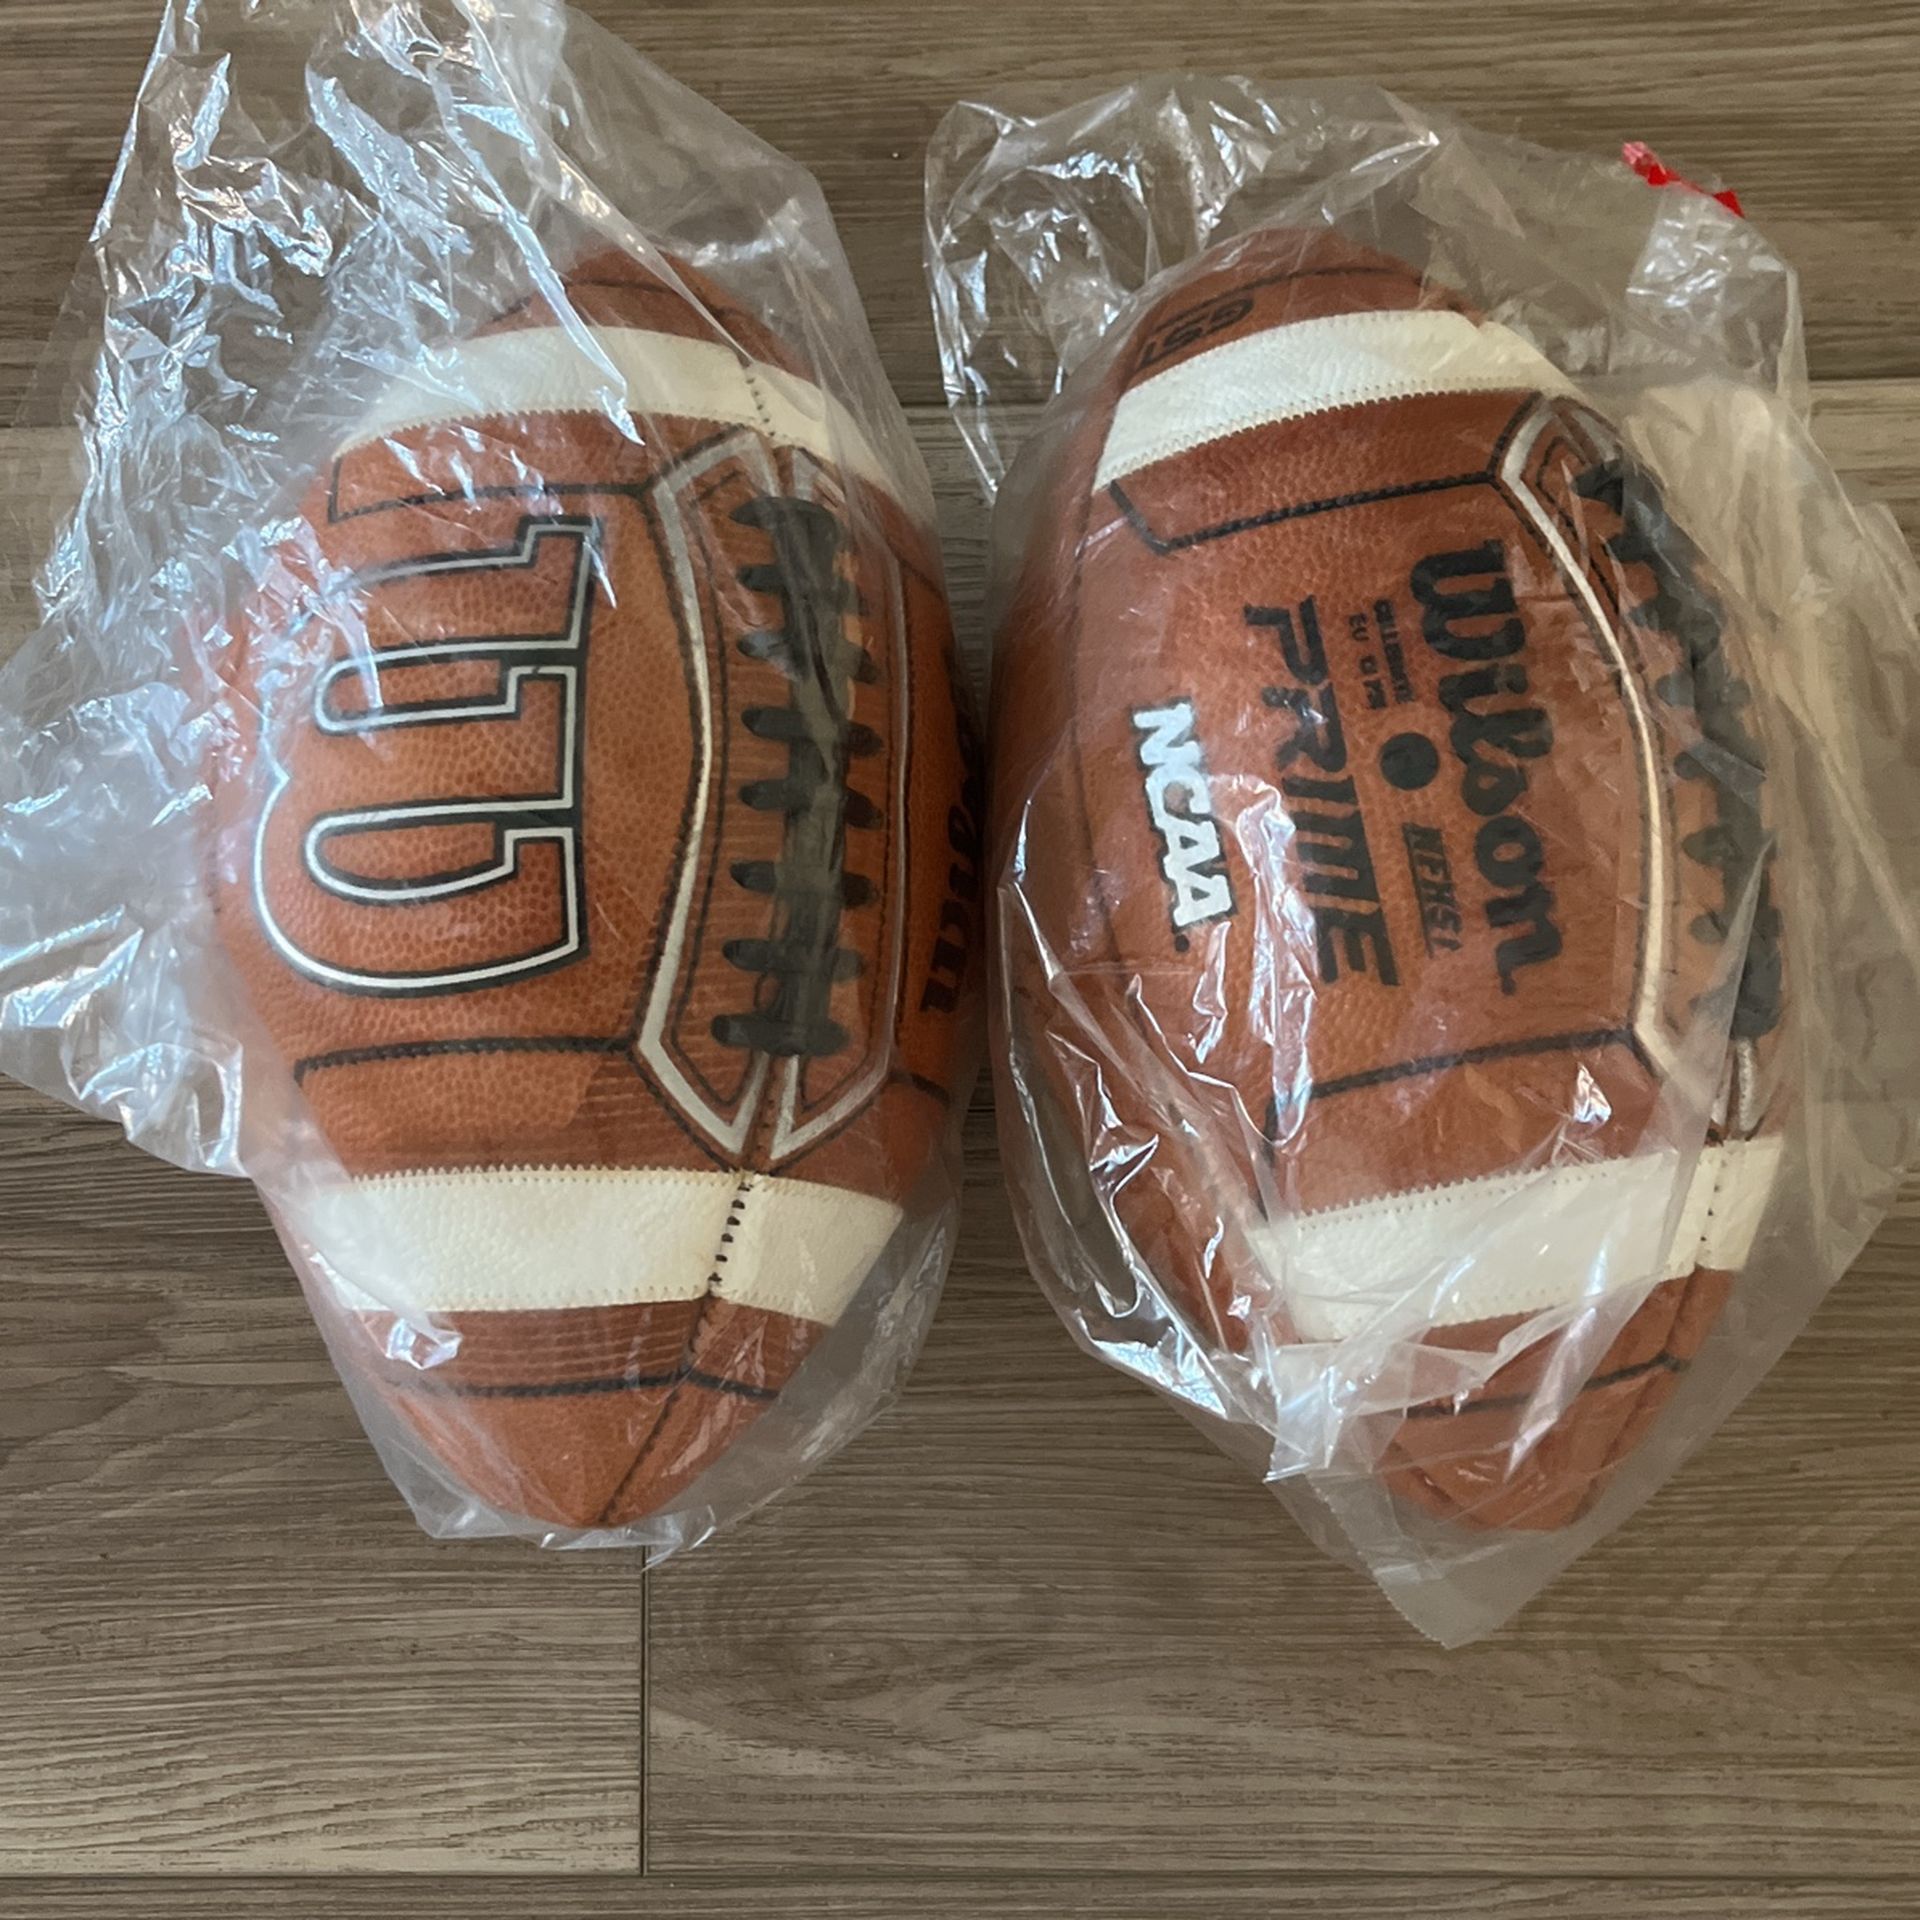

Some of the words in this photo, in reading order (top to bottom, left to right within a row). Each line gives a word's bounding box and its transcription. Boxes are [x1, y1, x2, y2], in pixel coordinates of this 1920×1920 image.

[1130, 698, 1237, 928] NCAA
[1243, 595, 1400, 987] PRIME
[1410, 538, 1563, 995] Wilson
